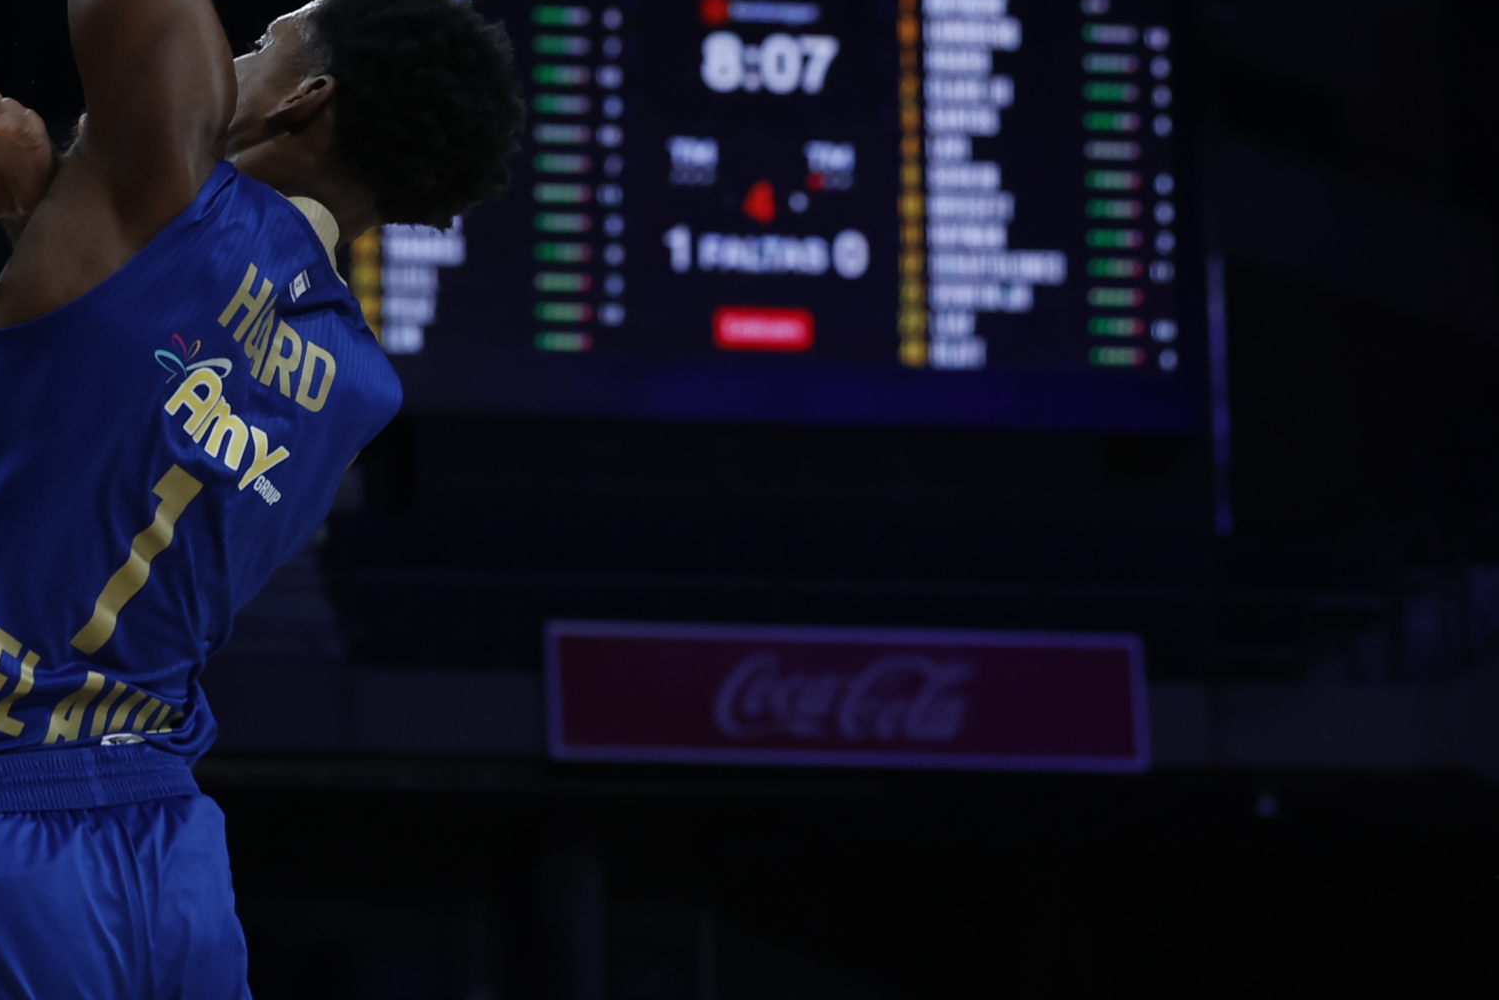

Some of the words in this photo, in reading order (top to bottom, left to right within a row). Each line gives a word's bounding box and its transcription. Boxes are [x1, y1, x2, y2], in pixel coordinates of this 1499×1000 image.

[701, 31, 840, 96] 8:07
[663, 224, 692, 273] 1
[697, 232, 831, 276] FALTAS
[832, 229, 870, 279] 0
[253, 474, 282, 506] GROUP
[69, 463, 204, 656] 1
